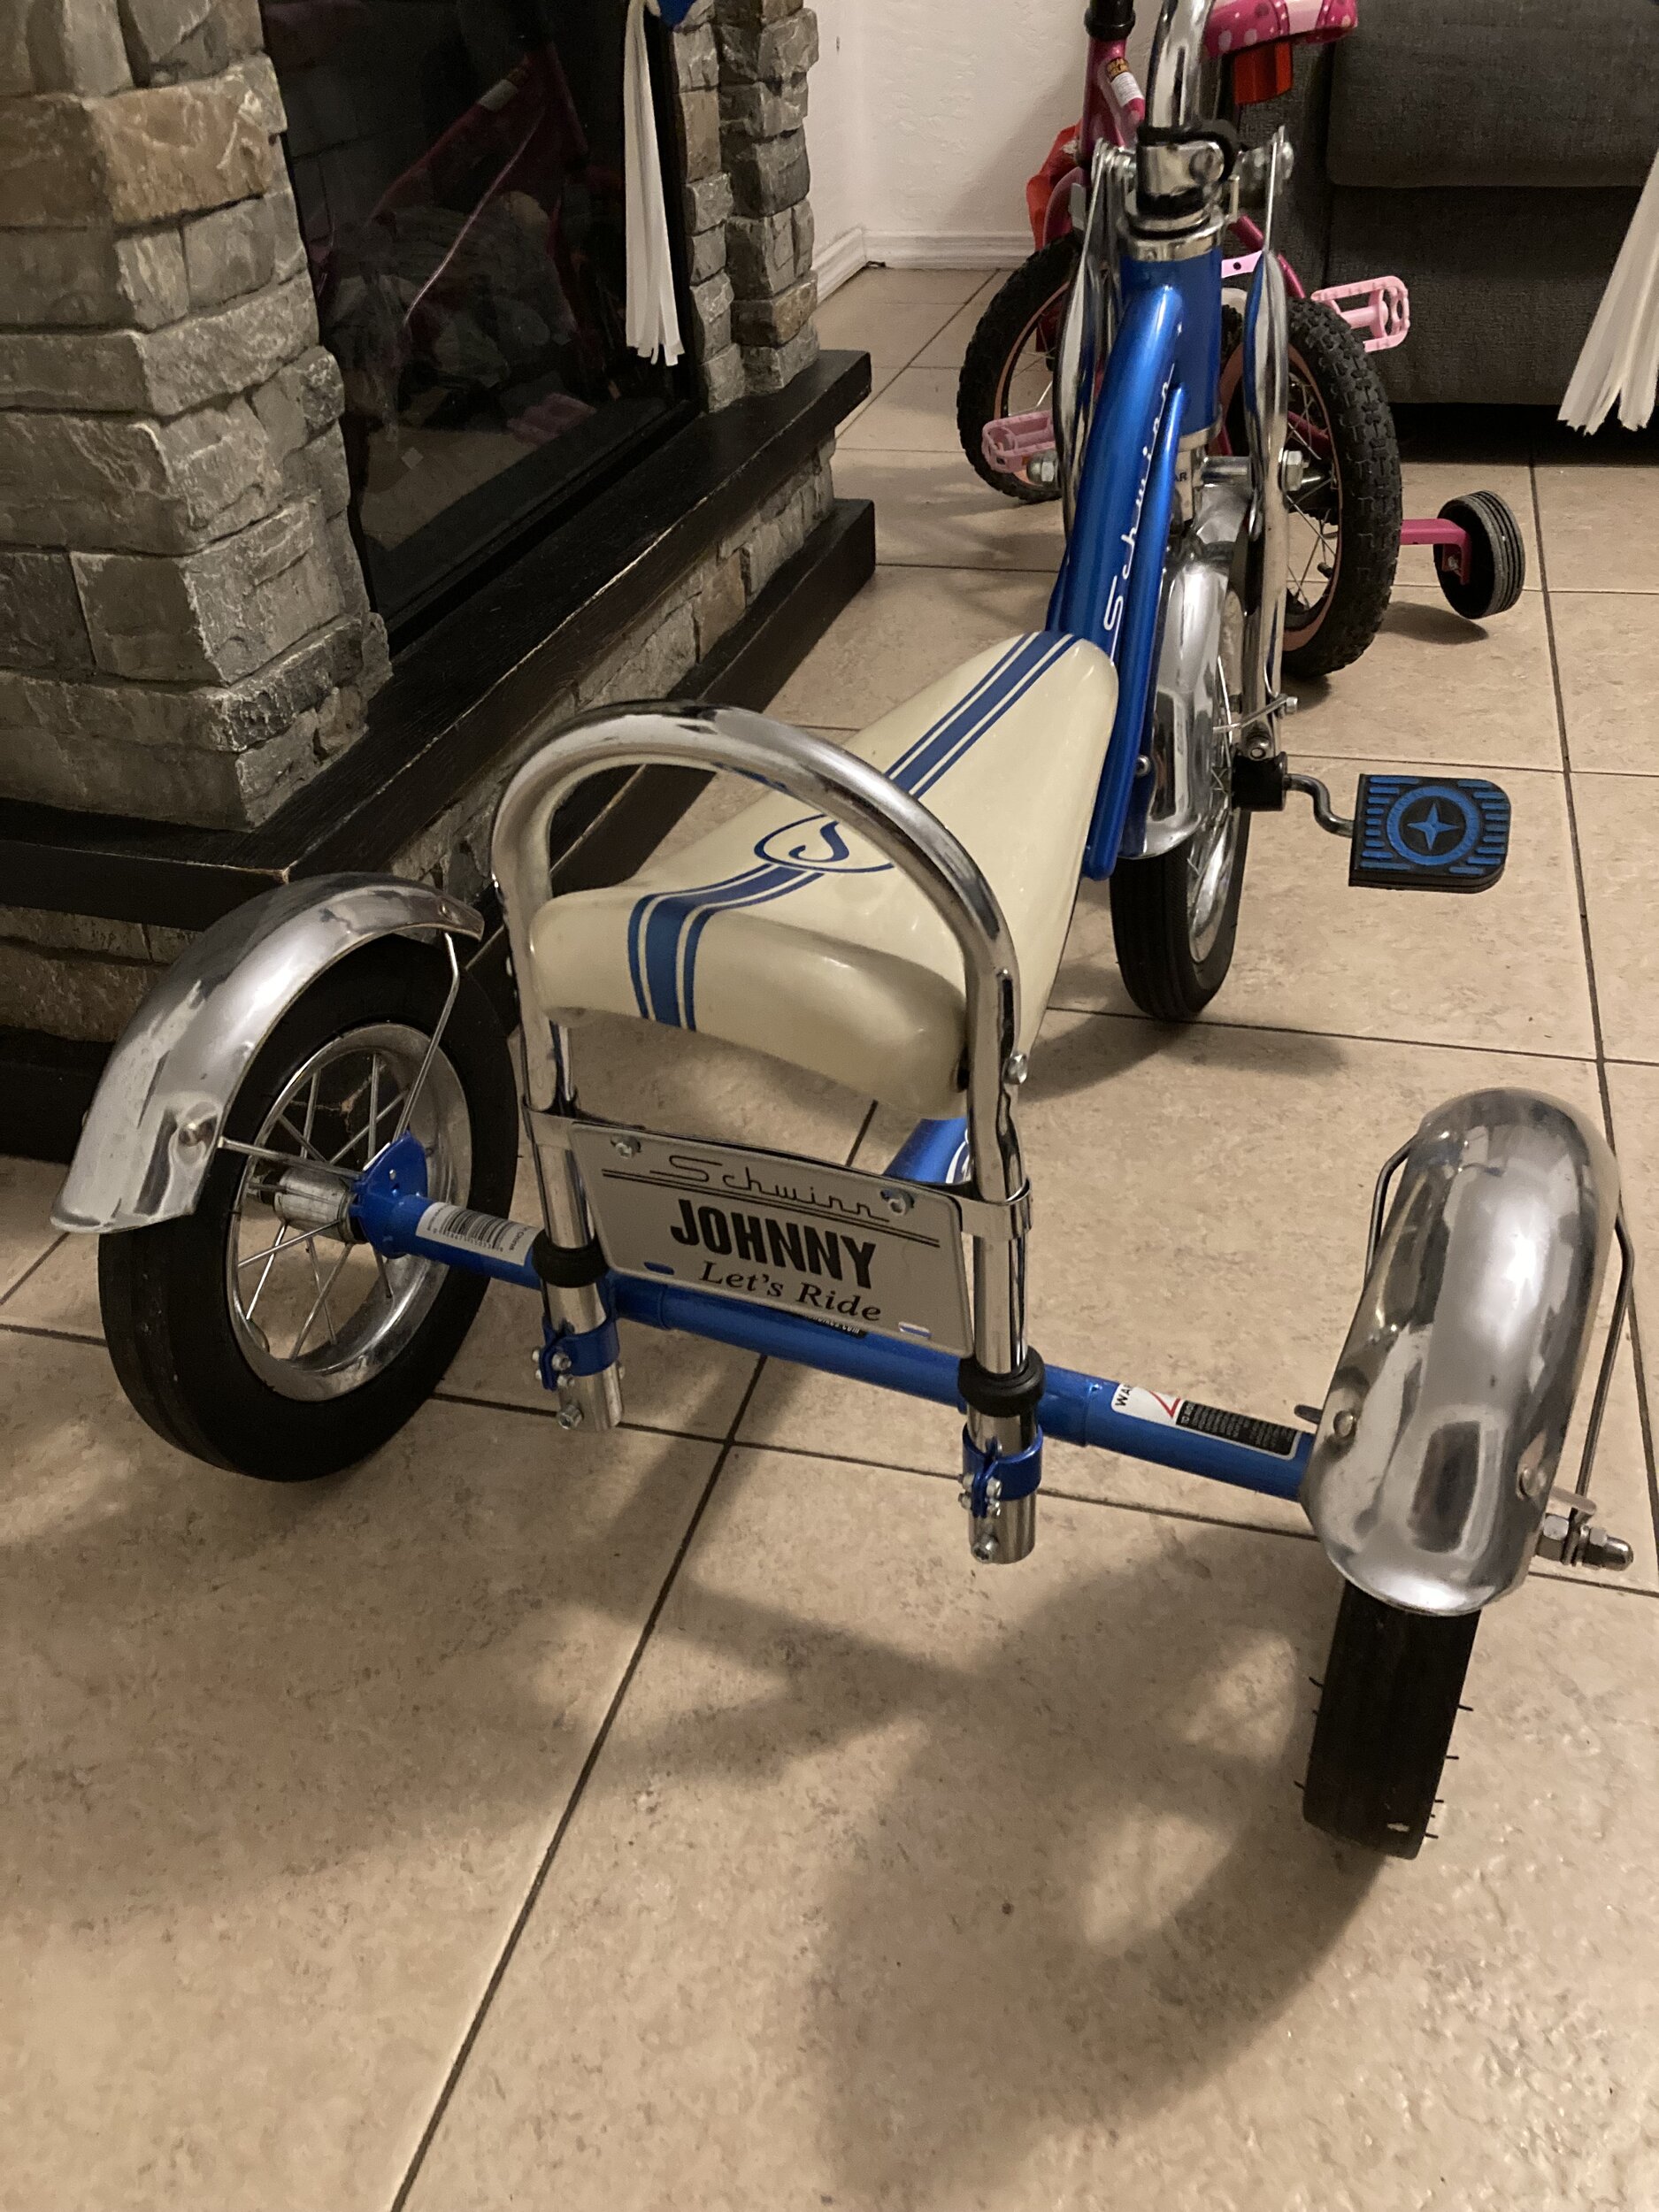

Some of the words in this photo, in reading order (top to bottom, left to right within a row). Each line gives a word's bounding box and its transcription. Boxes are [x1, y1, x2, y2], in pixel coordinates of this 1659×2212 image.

[649, 1155, 890, 1223] Schwinn
[670, 1198, 877, 1290] JOHNNY
[698, 1260, 784, 1298] Let's
[797, 1281, 882, 1323] Ride
